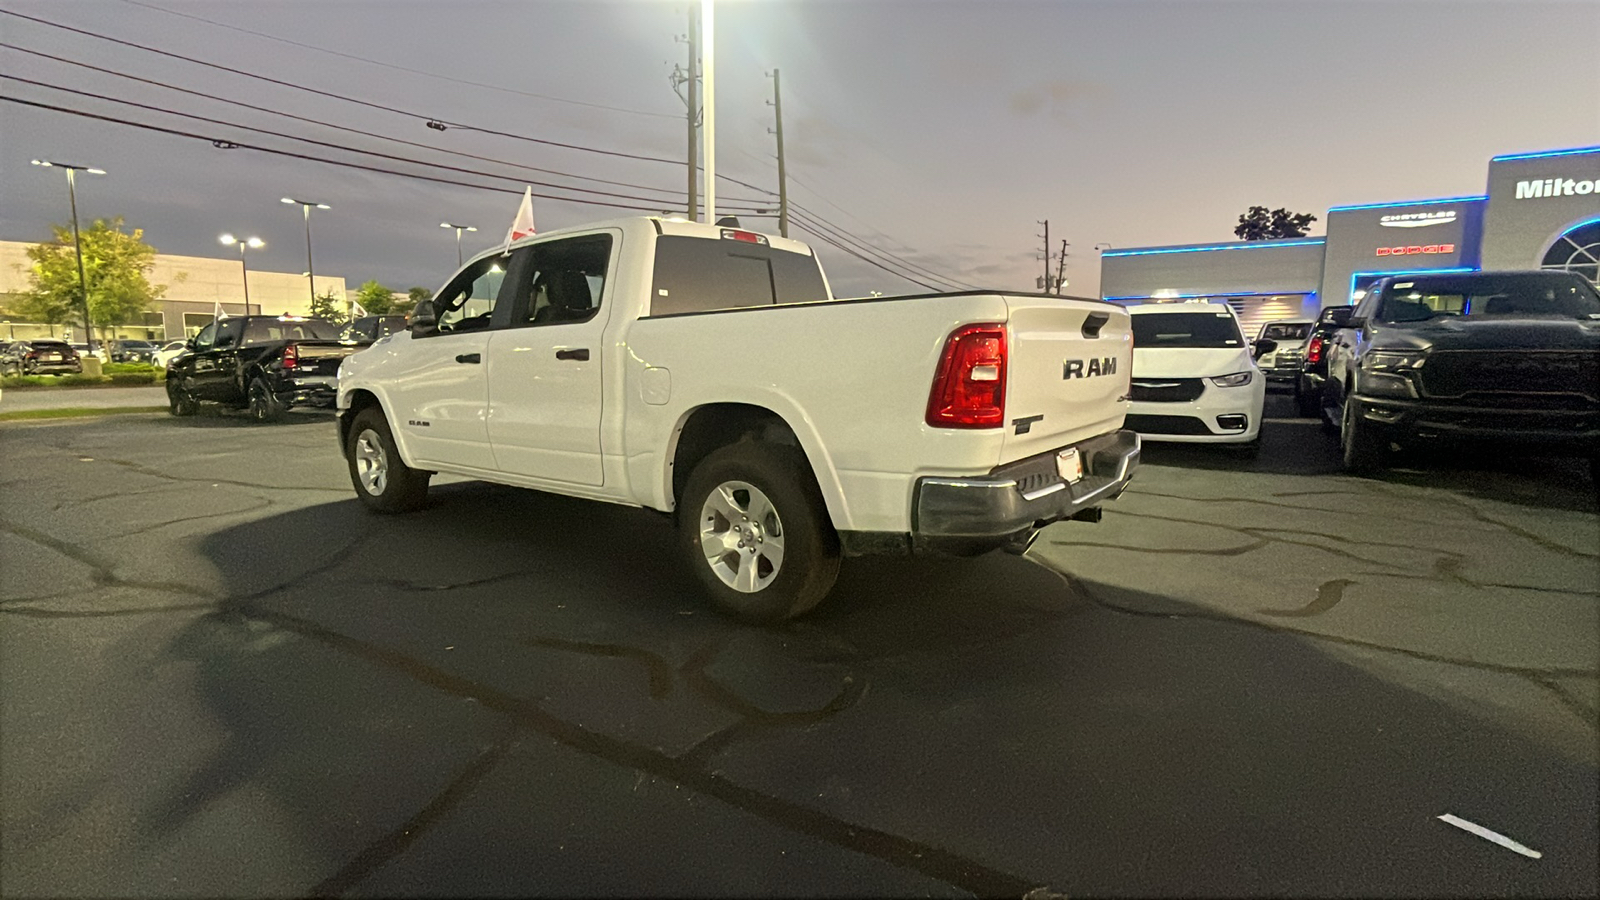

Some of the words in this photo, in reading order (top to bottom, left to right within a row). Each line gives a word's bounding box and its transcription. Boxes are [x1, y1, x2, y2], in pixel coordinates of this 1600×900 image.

[1515, 178, 1600, 199] Milto
[1380, 211, 1456, 222] CHRYSLER
[1376, 244, 1454, 257] DODGE
[1062, 357, 1116, 380] RAM
